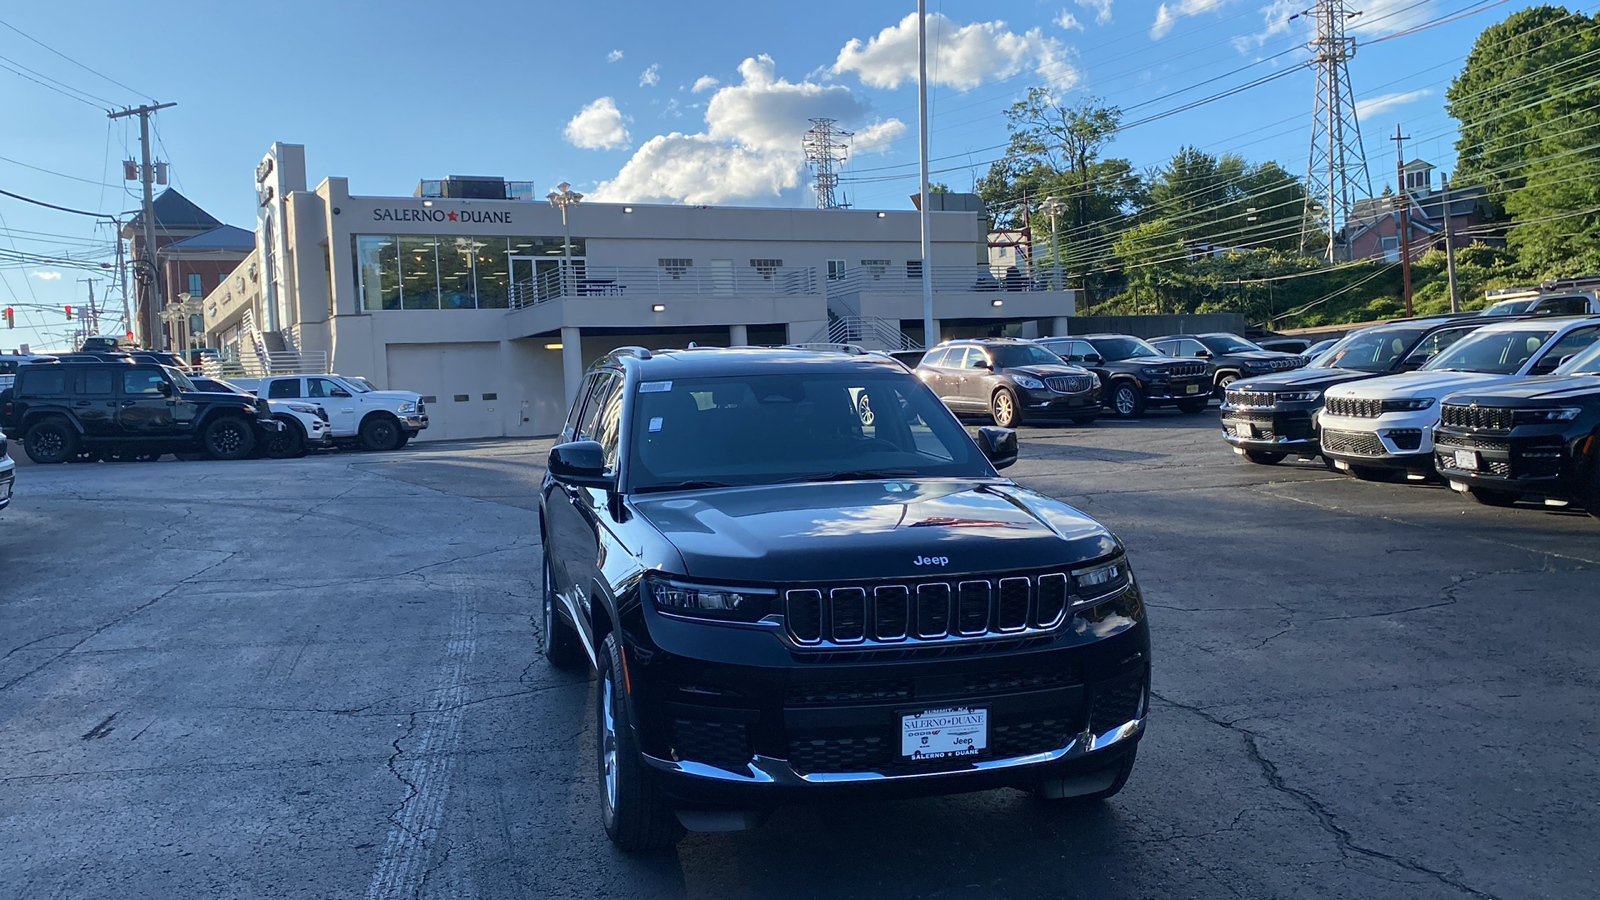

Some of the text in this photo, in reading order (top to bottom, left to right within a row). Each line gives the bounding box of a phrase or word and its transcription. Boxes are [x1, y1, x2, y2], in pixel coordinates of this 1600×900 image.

[373, 208, 512, 224] SALERNO DUANE
[913, 555, 949, 567] Jeep
[904, 718, 947, 730] SALERNO
[951, 714, 984, 726] DUANE
[953, 737, 973, 745] Jeep
[911, 748, 979, 760] SALERNO DUANE
